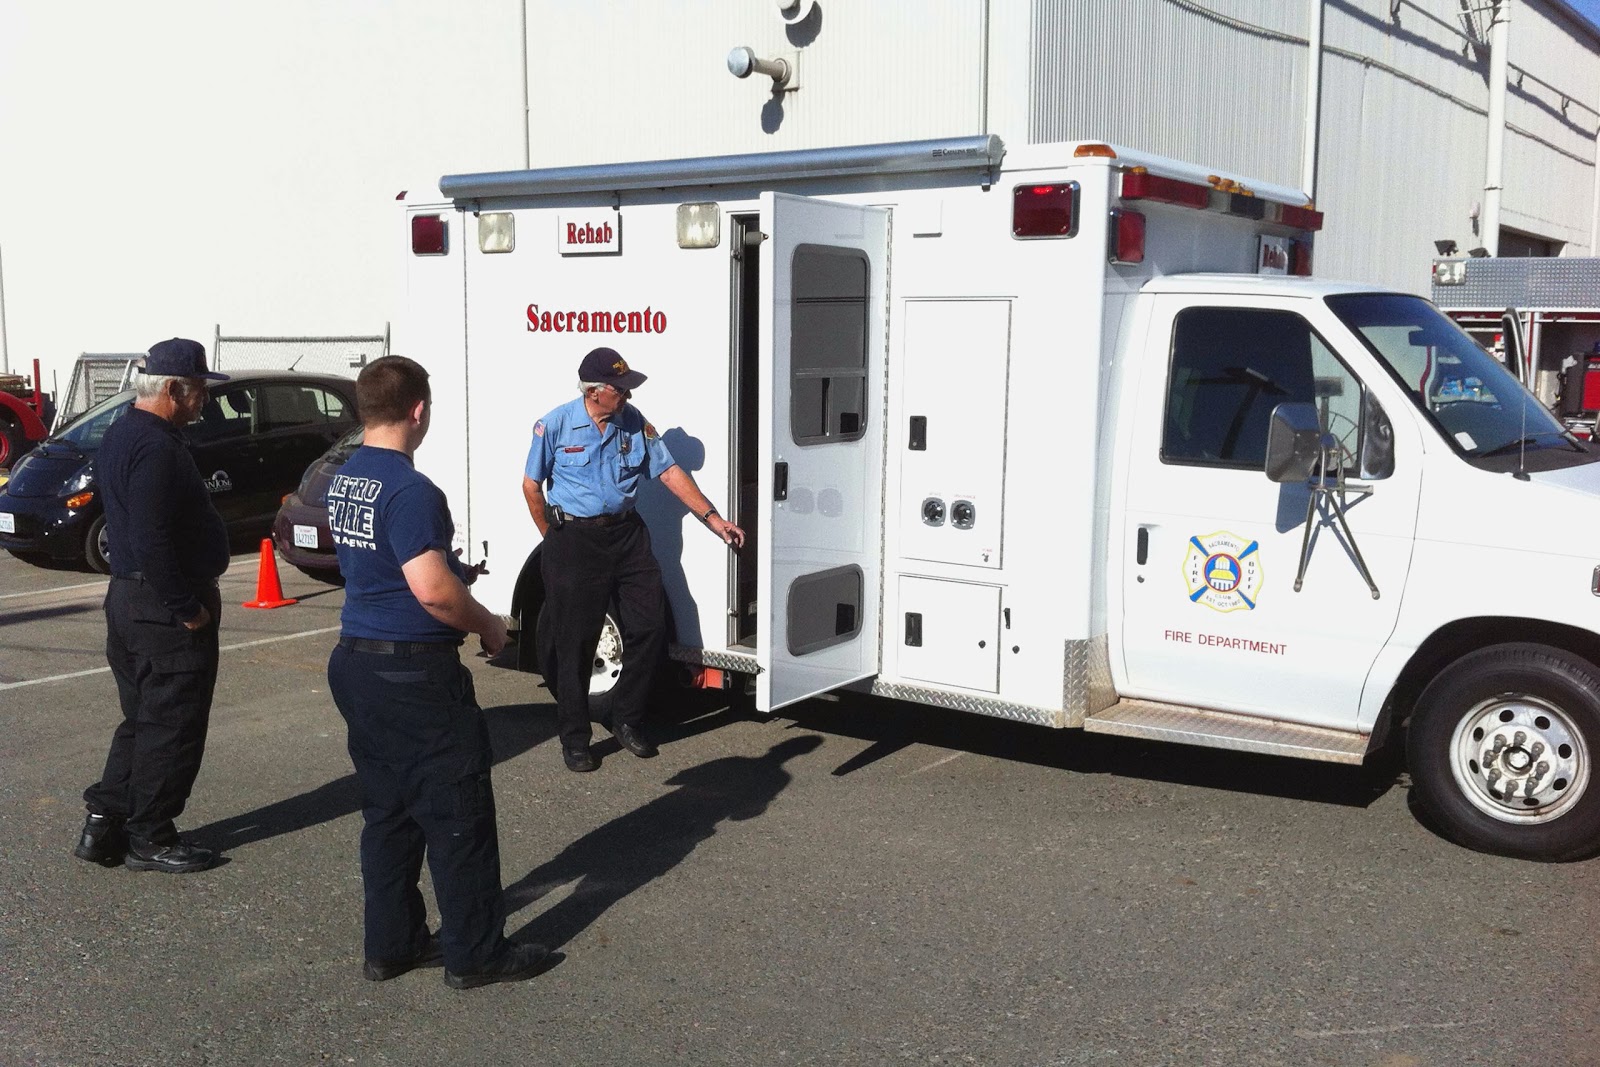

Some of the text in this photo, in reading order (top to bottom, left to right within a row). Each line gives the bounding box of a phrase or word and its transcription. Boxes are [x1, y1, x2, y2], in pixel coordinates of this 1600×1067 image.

[567, 221, 613, 245] Rehab
[526, 303, 667, 334] Sacramento
[328, 500, 374, 540] FIRE
[1208, 541, 1240, 552] SACRAMENTO
[1247, 561, 1255, 590] BUFF
[1164, 630, 1287, 655] FIRE DEPARTMENT
